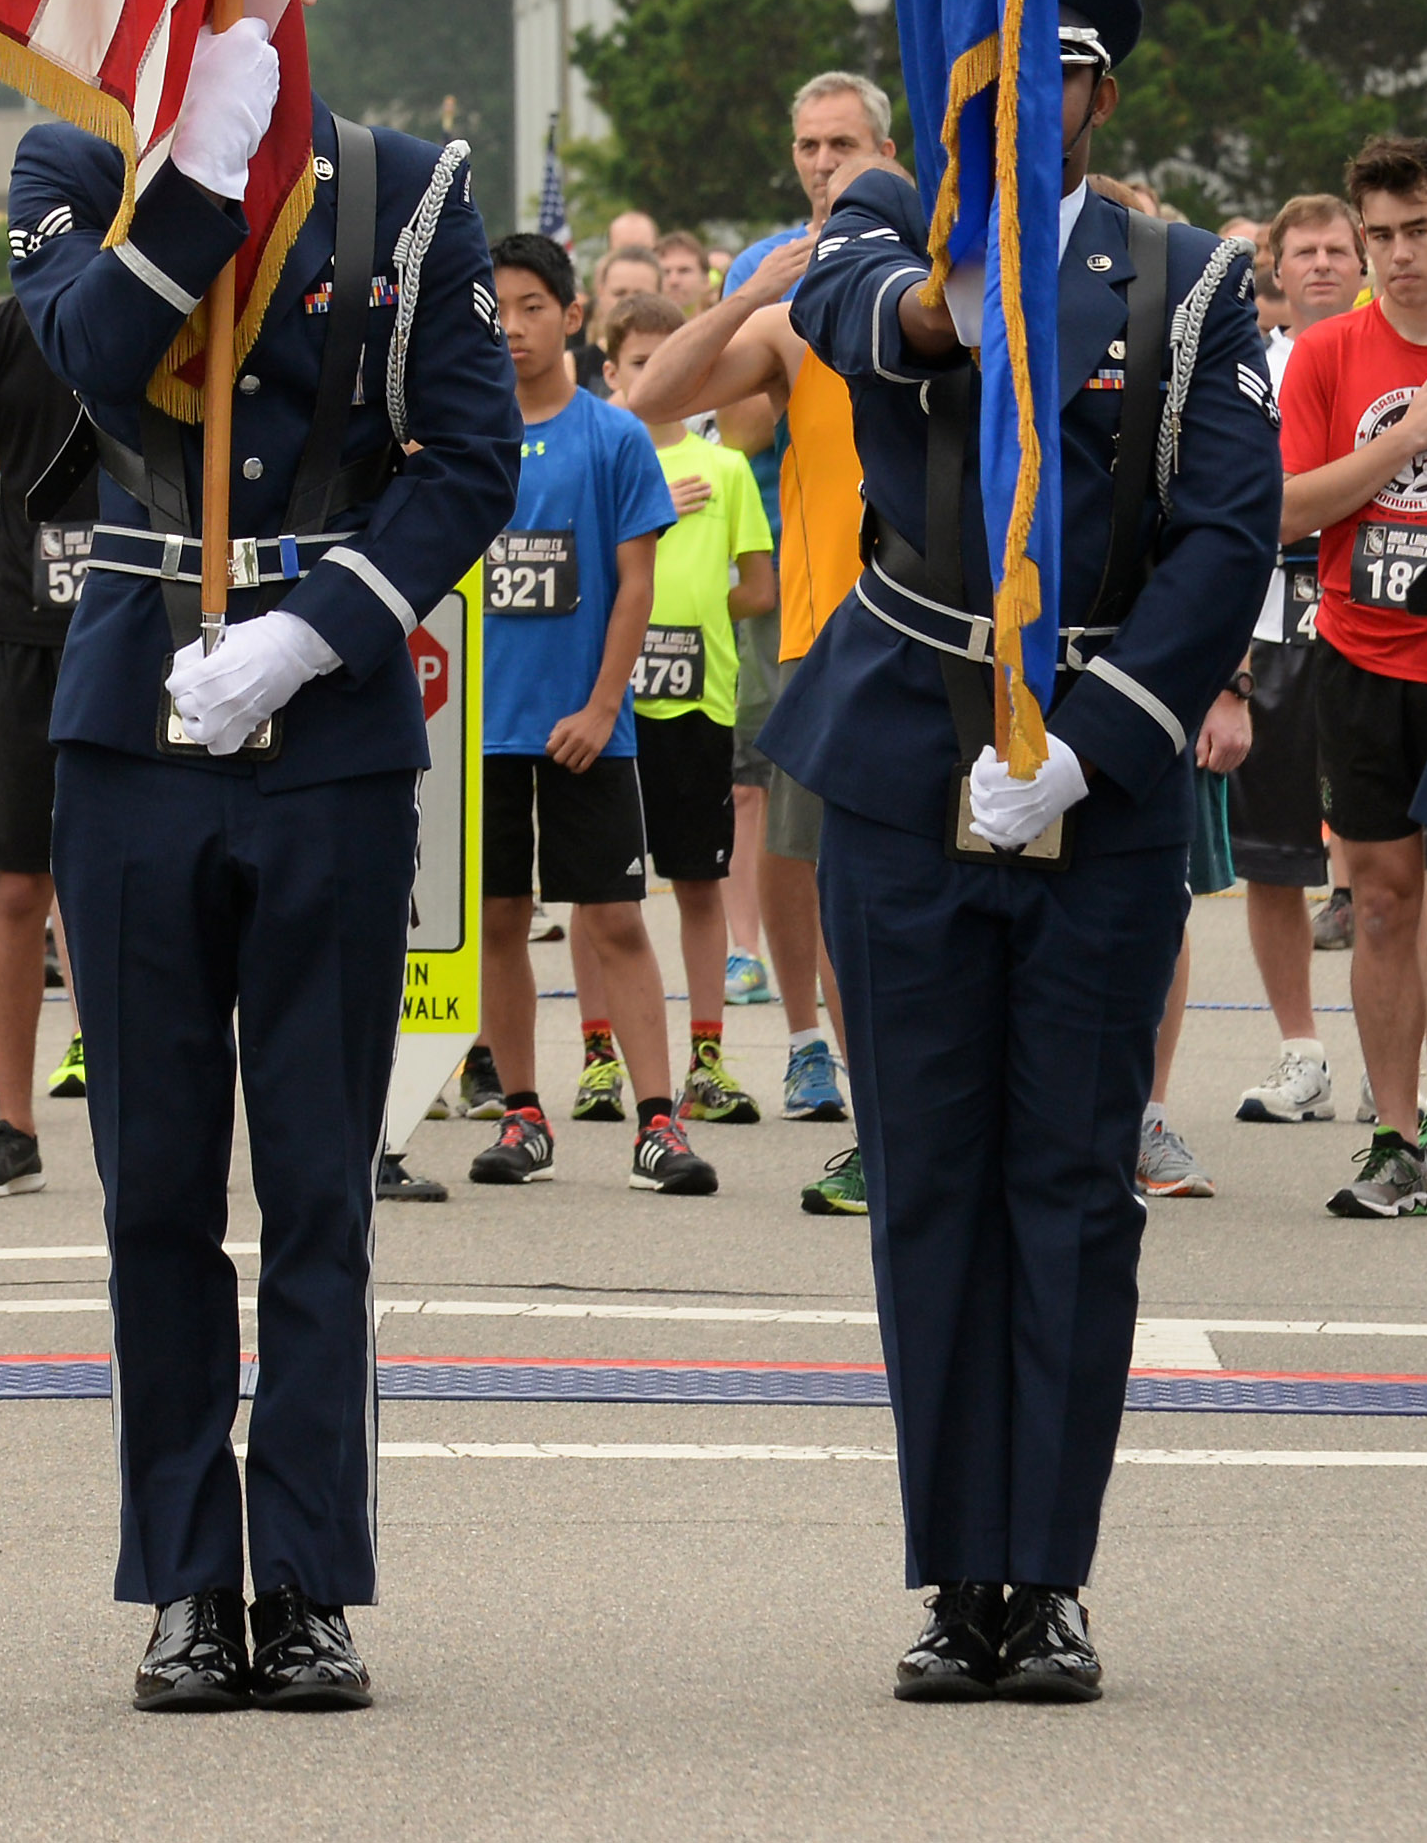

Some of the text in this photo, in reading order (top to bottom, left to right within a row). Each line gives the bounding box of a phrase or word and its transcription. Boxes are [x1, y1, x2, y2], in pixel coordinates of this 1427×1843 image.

[48, 559, 91, 603] 52
[490, 567, 555, 608] 321
[1367, 559, 1425, 602] 18
[1297, 603, 1318, 640] 4
[629, 656, 693, 696] 479
[406, 962, 428, 985] IN
[401, 996, 459, 1020] WALK
